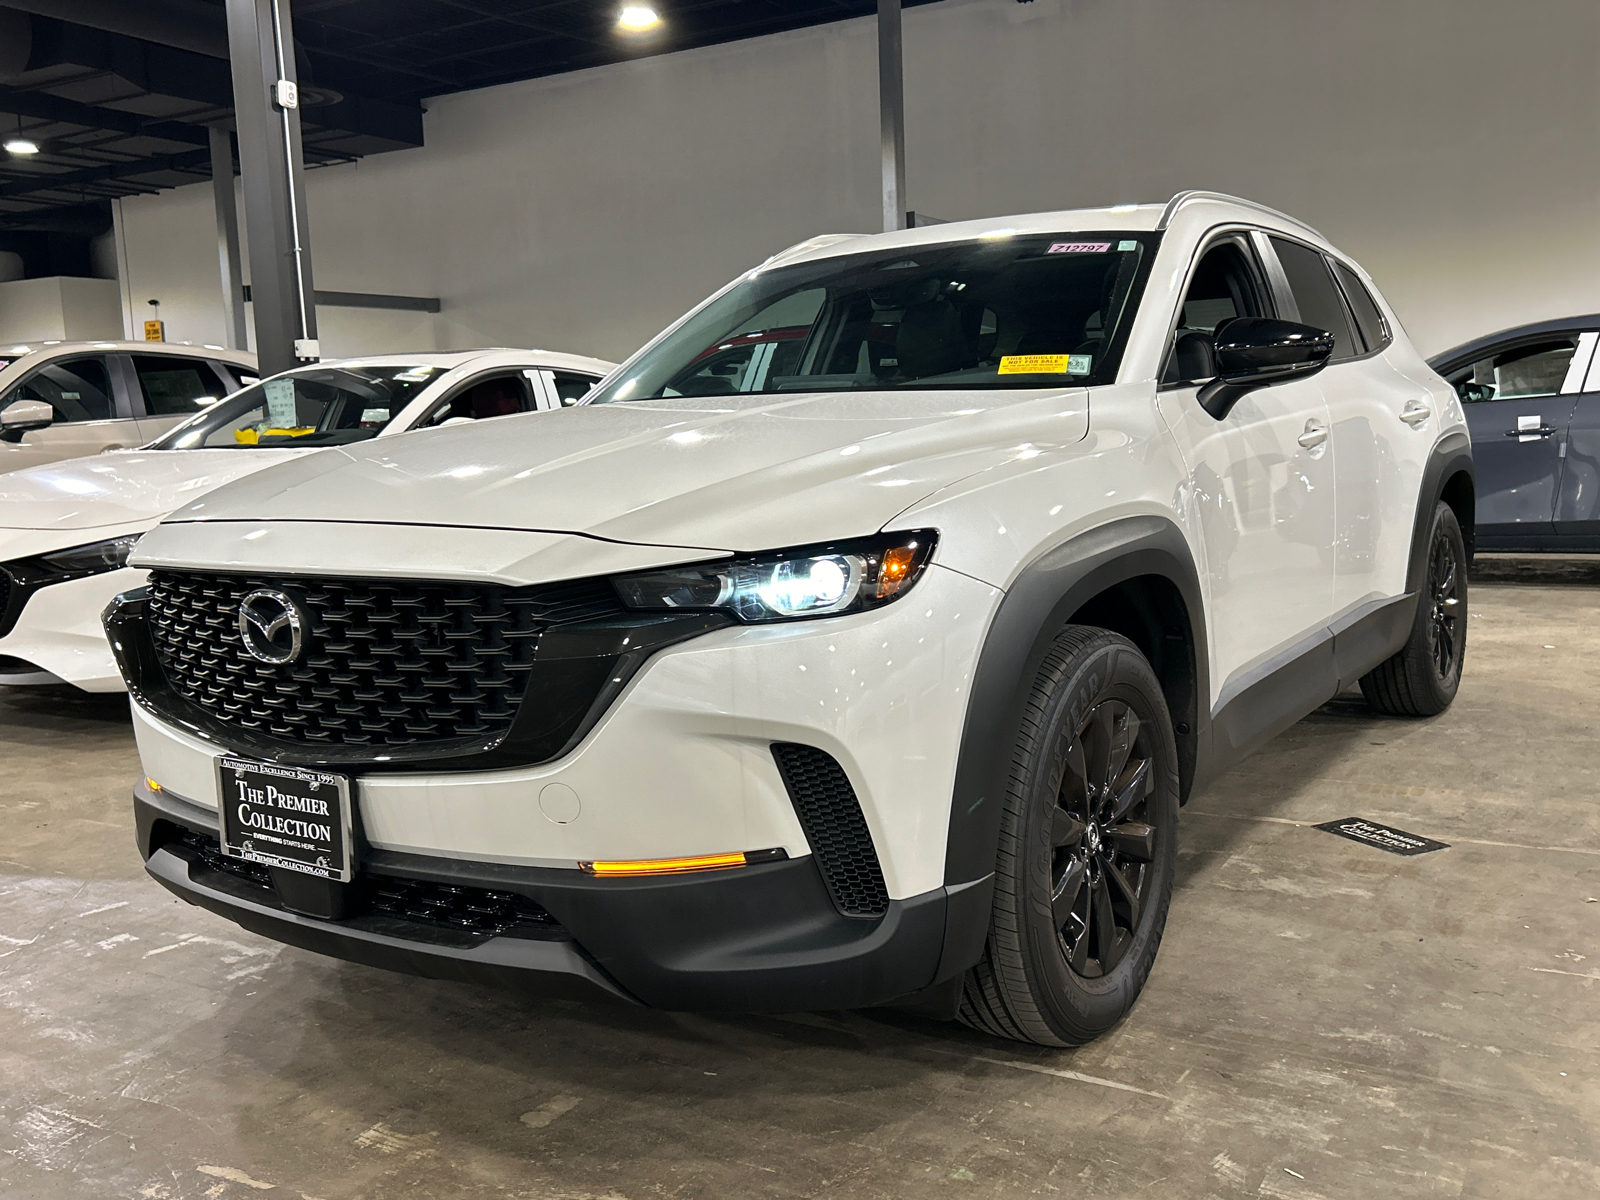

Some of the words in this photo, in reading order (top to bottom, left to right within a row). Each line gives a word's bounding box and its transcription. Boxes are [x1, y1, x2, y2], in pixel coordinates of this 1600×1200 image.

[222, 759, 259, 773] AUTOMOTIVE
[260, 765, 296, 778] EXCELLENCE
[297, 771, 316, 781] SINCE
[317, 774, 335, 785] 1995
[235, 779, 266, 805] THE
[266, 785, 330, 816] PREMIER
[238, 803, 331, 842] COLLECTION
[253, 832, 283, 845] EVERYTHING
[283, 838, 301, 848] STARTS
[1340, 824, 1416, 850] COLLECTION
